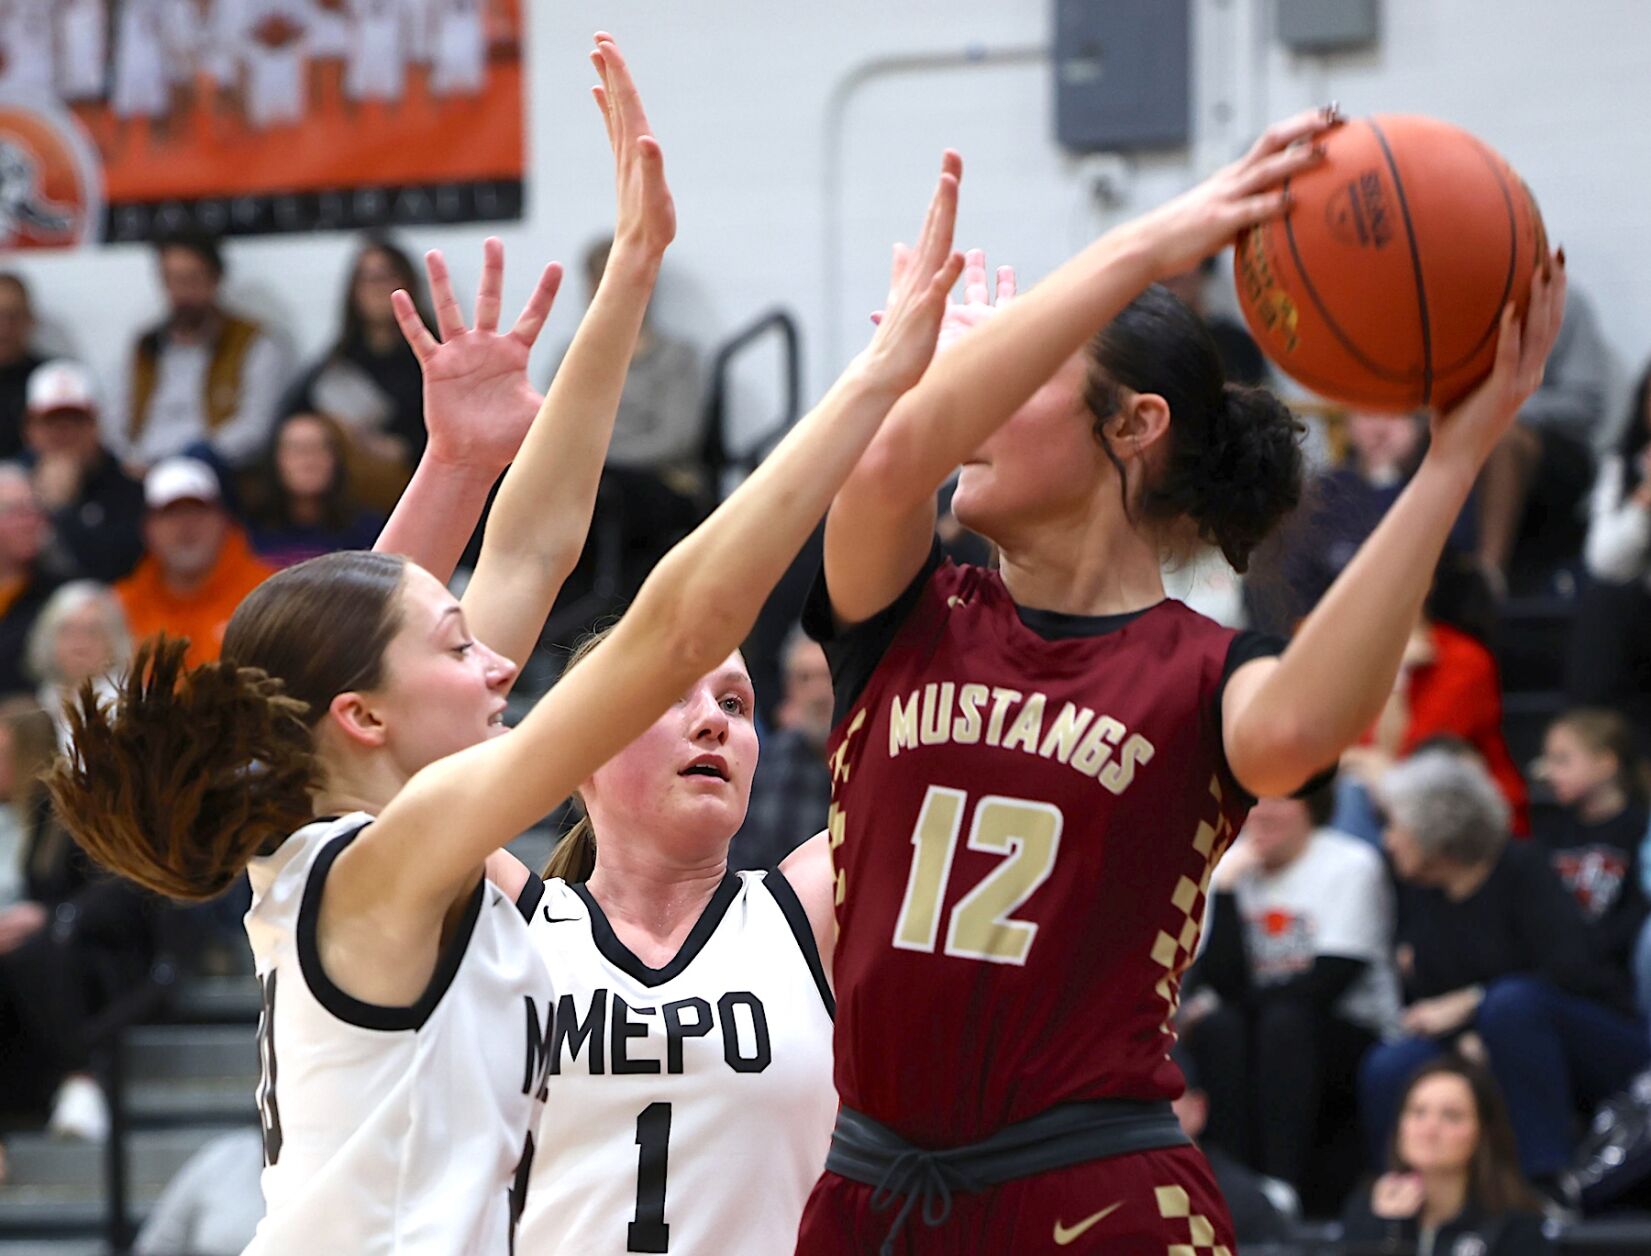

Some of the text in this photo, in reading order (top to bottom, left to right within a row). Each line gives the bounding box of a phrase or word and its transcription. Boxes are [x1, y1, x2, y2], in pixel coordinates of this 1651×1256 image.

[889, 681, 1155, 796] MUSTANGS
[892, 784, 1064, 967] 12
[550, 988, 772, 1076] MEPO
[626, 1101, 673, 1255] 1
